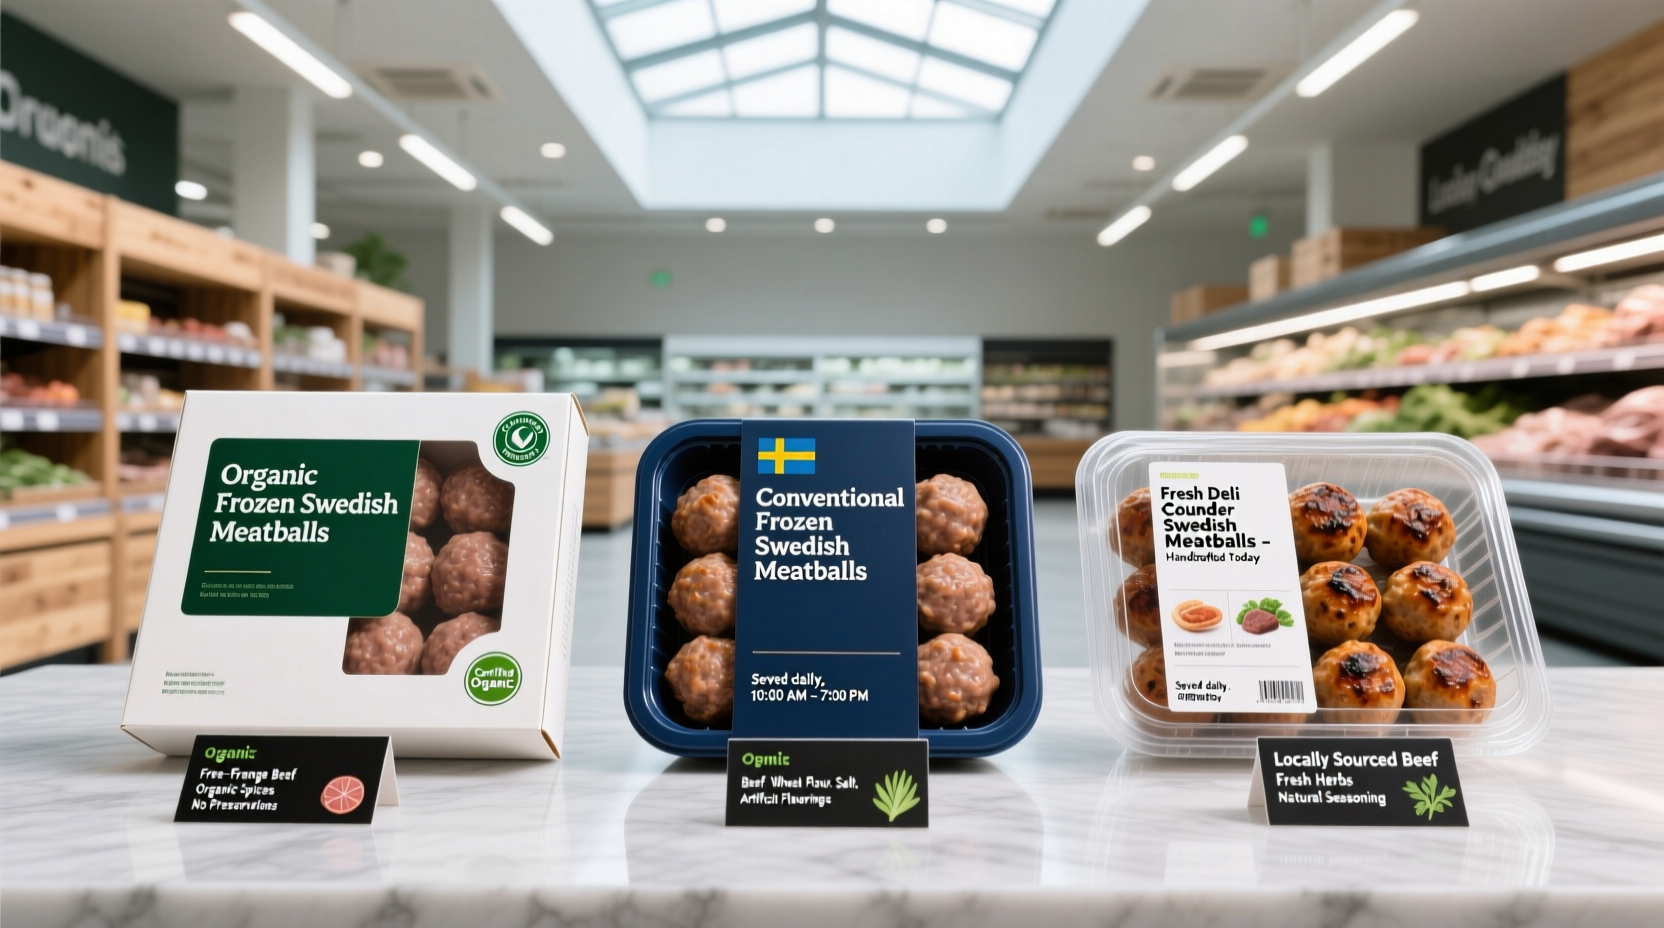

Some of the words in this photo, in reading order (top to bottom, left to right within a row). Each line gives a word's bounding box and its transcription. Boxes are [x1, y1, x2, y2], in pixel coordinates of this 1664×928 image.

[221, 463, 318, 491] Organic
[756, 487, 904, 508] Conventional
[1161, 486, 1204, 500] Fresh
[1208, 486, 1240, 500] Deli
[214, 492, 295, 514] Frozen
[300, 491, 398, 514] Swedish
[1161, 502, 1235, 516] Counder
[755, 511, 834, 531] Frozen
[1163, 518, 1237, 532] Swedish
[209, 520, 330, 543] Meatballs
[755, 535, 850, 556] Swedish
[1165, 533, 1257, 548] Meatballs
[1229, 552, 1260, 565] Today
[754, 560, 868, 581] Meatballs
[751, 689, 784, 702] 10:00
[786, 689, 807, 702] AM
[820, 689, 847, 702] 7:00
[849, 689, 869, 702] PM
[1274, 751, 1329, 770] Locally
[1333, 751, 1398, 768] Sourced
[1402, 751, 1439, 768] Beef
[1276, 772, 1312, 787] Fresh
[1315, 772, 1354, 787] Herbs
[191, 798, 207, 811] No
[1278, 791, 1323, 804] Natural
[1325, 790, 1387, 807] Seasoning
